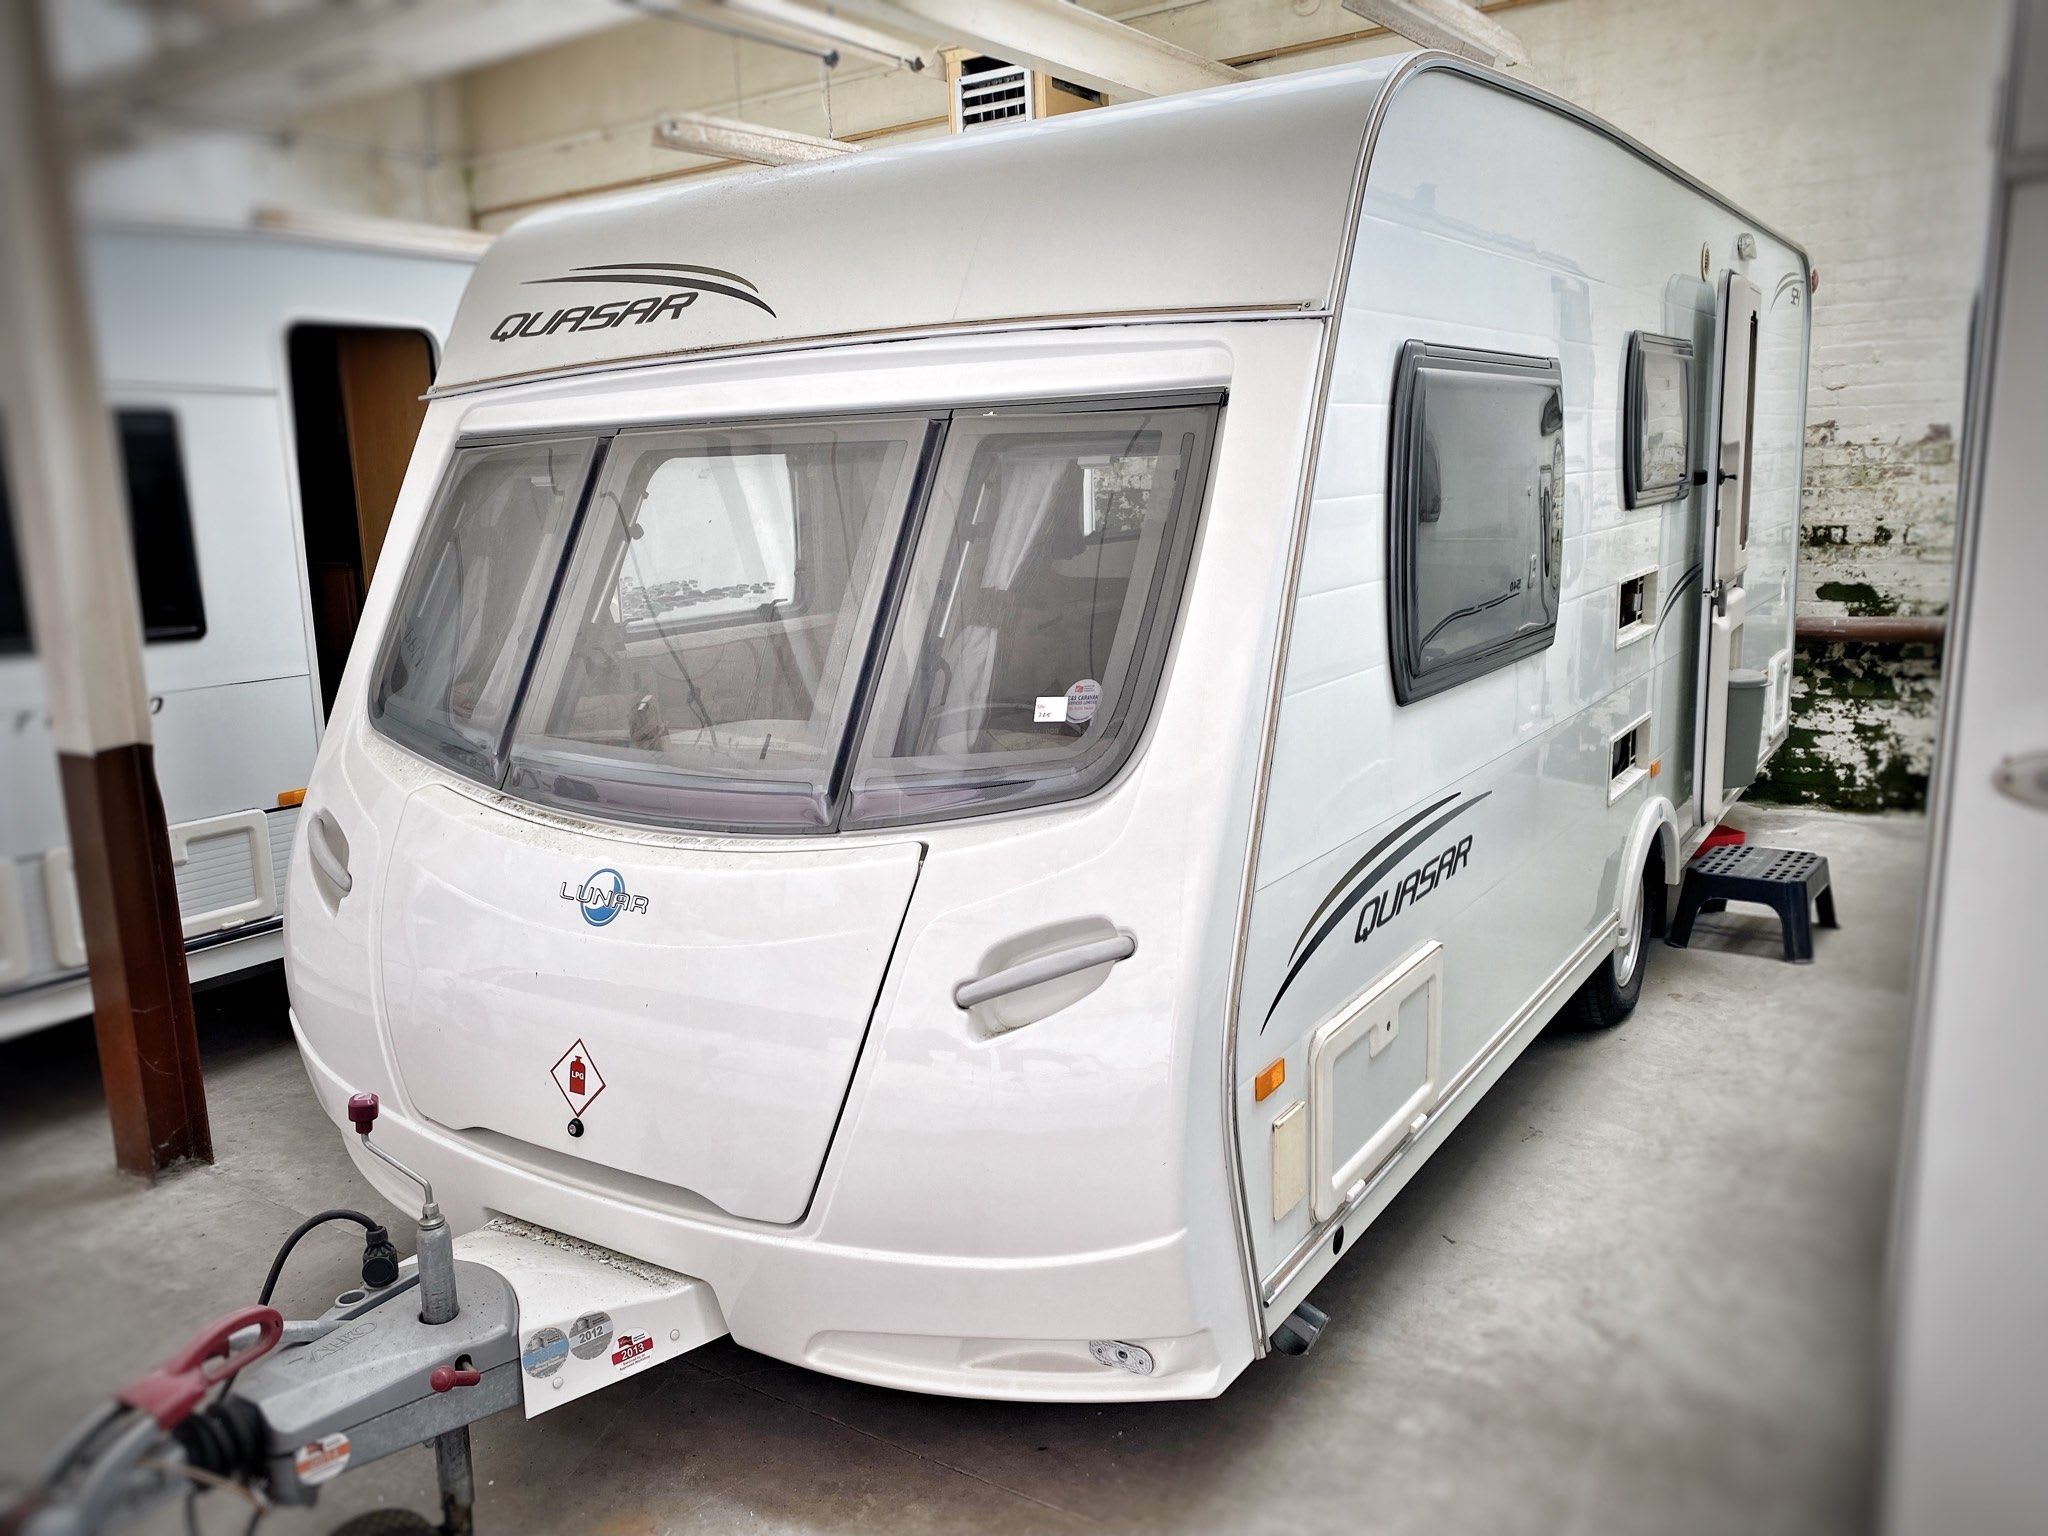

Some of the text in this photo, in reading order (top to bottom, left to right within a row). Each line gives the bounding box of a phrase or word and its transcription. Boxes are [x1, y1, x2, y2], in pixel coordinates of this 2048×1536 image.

[490, 292, 698, 342] QUASAR
[560, 881, 649, 914] LUNAR
[1354, 834, 1473, 944] QUASAR
[571, 1070, 584, 1080] LPG
[579, 1326, 604, 1343] 2012
[621, 1343, 645, 1361] 2013
